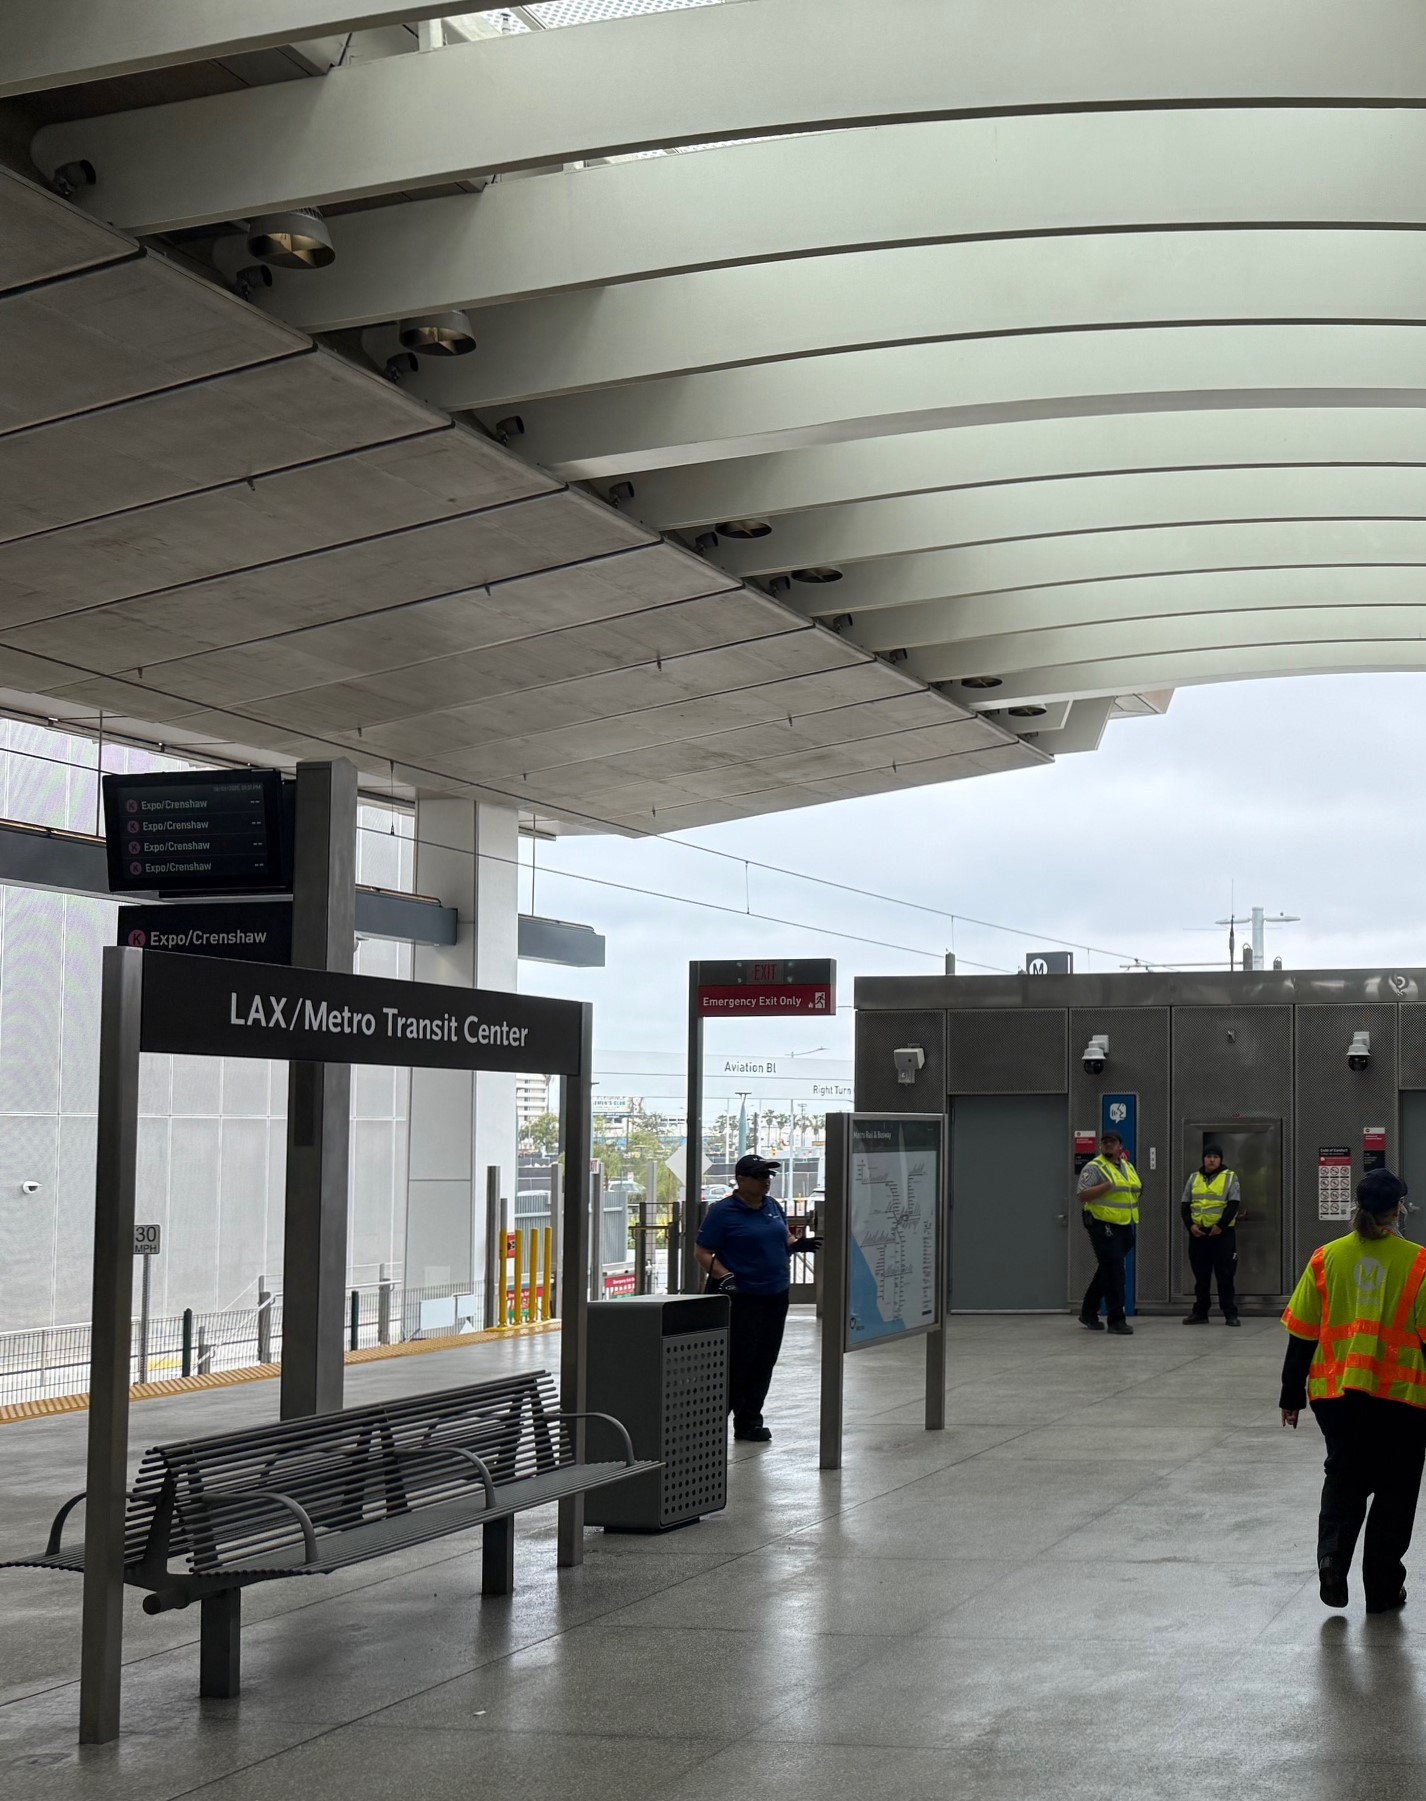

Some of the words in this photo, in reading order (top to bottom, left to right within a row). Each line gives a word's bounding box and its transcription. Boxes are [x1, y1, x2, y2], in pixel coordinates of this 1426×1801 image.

[141, 800, 208, 812] Expo/Crenshaw
[143, 820, 209, 832] Expo/Crenshaw
[144, 841, 210, 853] Expo/Crenshaw
[145, 863, 212, 874] Expo/Crenshaw
[150, 930, 267, 948] Expo/Crenshaw
[754, 964, 776, 981] EXIT
[703, 997, 756, 1008] Emergency
[759, 996, 777, 1006] Exit
[780, 996, 802, 1007] Only
[230, 992, 376, 1036] LAX/Metro
[383, 1008, 458, 1042] Transit
[463, 1015, 528, 1047] Center
[724, 1061, 764, 1073] Aviation
[766, 1062, 776, 1073] Bl
[813, 1085, 833, 1096] Right
[834, 1086, 851, 1095] Turn
[136, 1226, 156, 1242] 30
